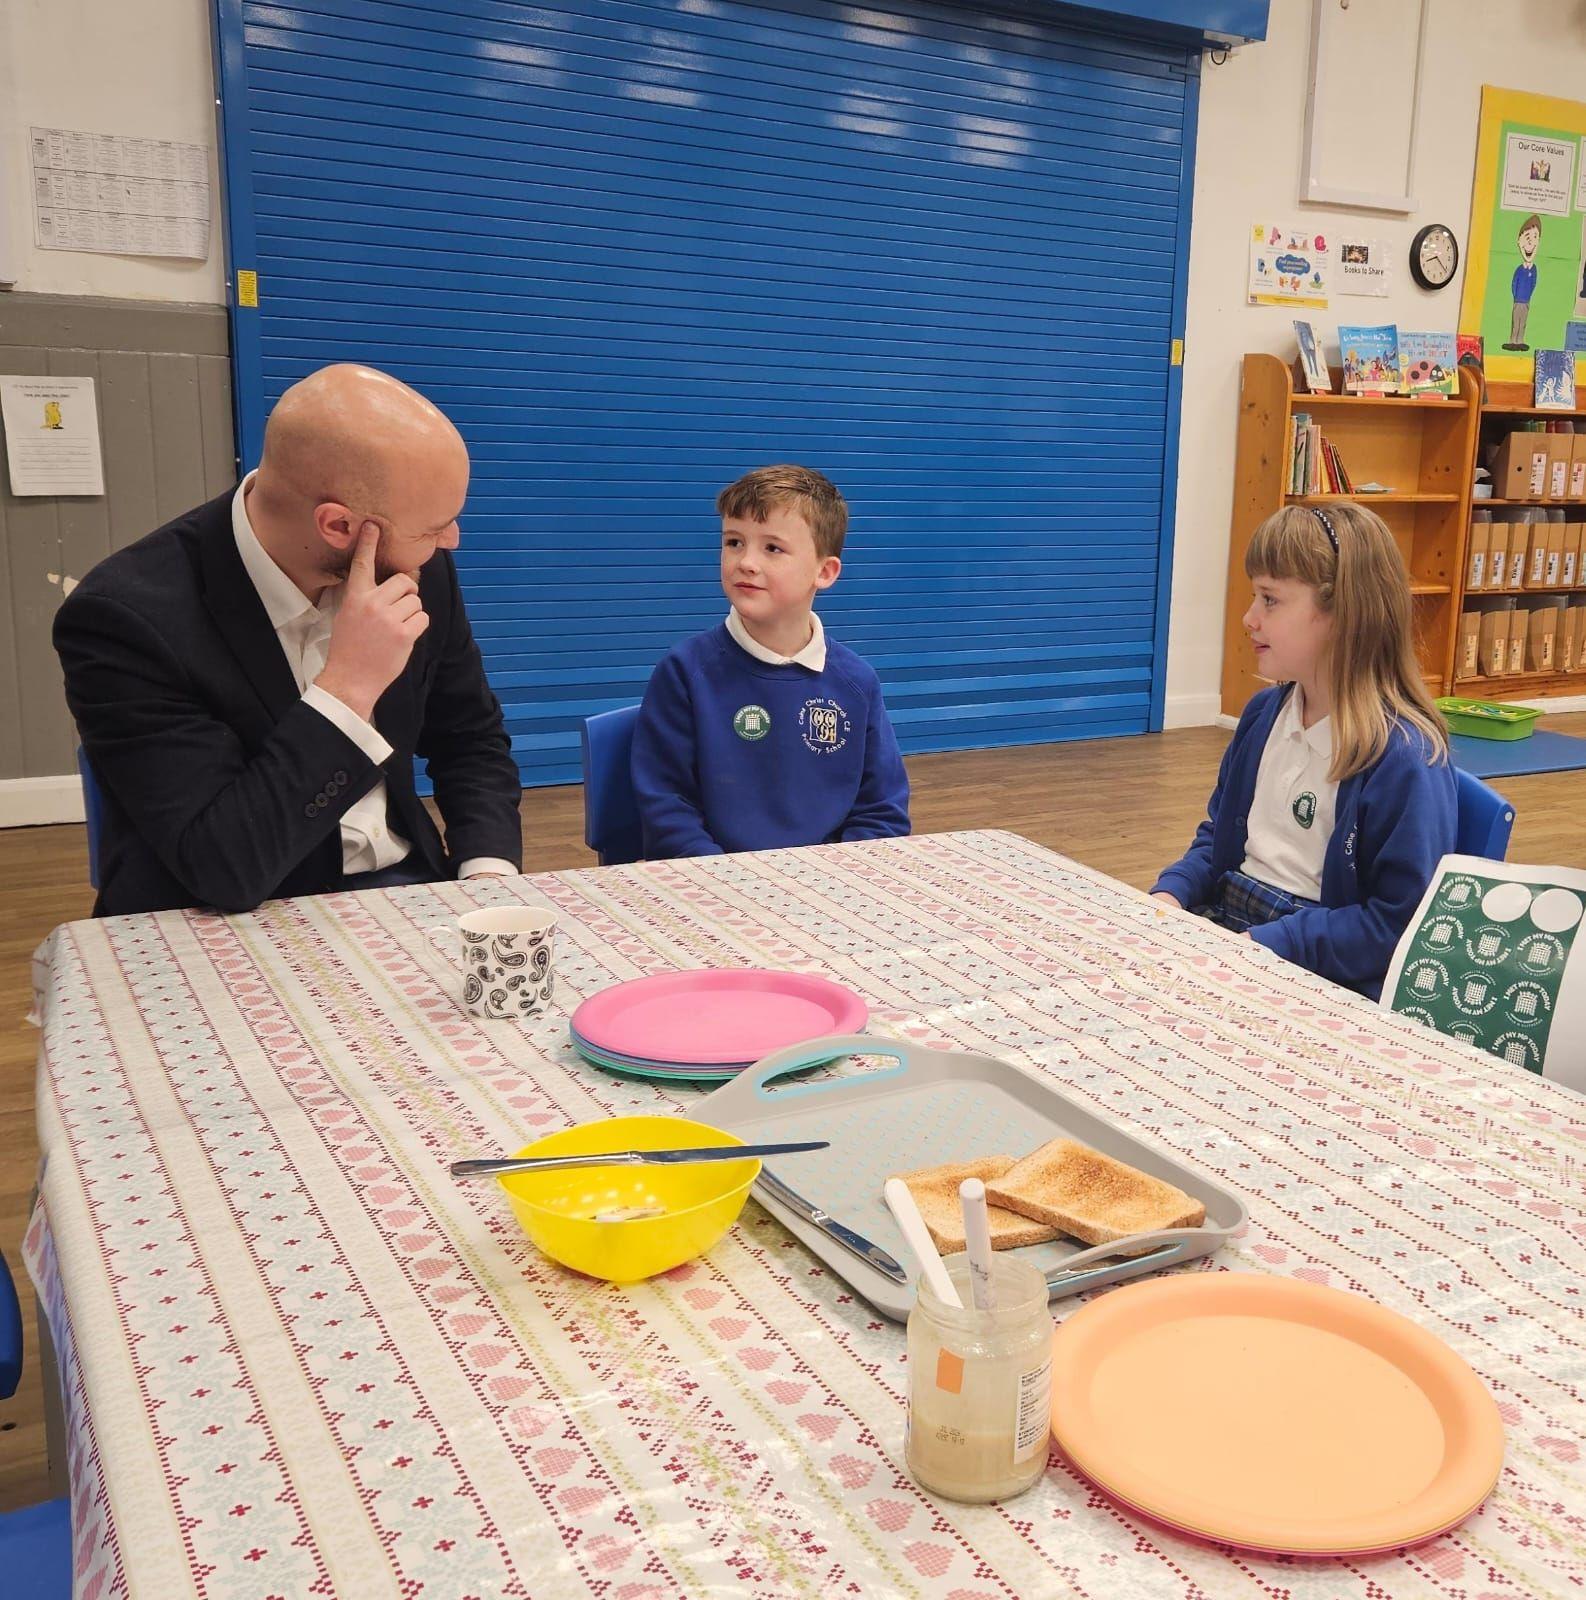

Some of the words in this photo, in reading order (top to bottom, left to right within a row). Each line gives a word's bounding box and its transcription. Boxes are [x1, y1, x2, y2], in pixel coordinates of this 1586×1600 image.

[1518, 141, 1530, 150] Our
[1531, 143, 1545, 153] Core
[1546, 145, 1565, 156] Values
[1344, 265, 1361, 274] Books
[1368, 266, 1385, 276] Share
[825, 737, 847, 754] School
[1344, 832, 1356, 856] Colne
[1454, 919, 1464, 940] TODAY
[1465, 938, 1476, 960] TODAY
[1553, 938, 1564, 961] TODAY
[1438, 963, 1450, 987] TODAY
[1452, 986, 1463, 1009] TODAY
[1539, 986, 1551, 1011] TODAY
[1527, 1038, 1540, 1063] TODAY
